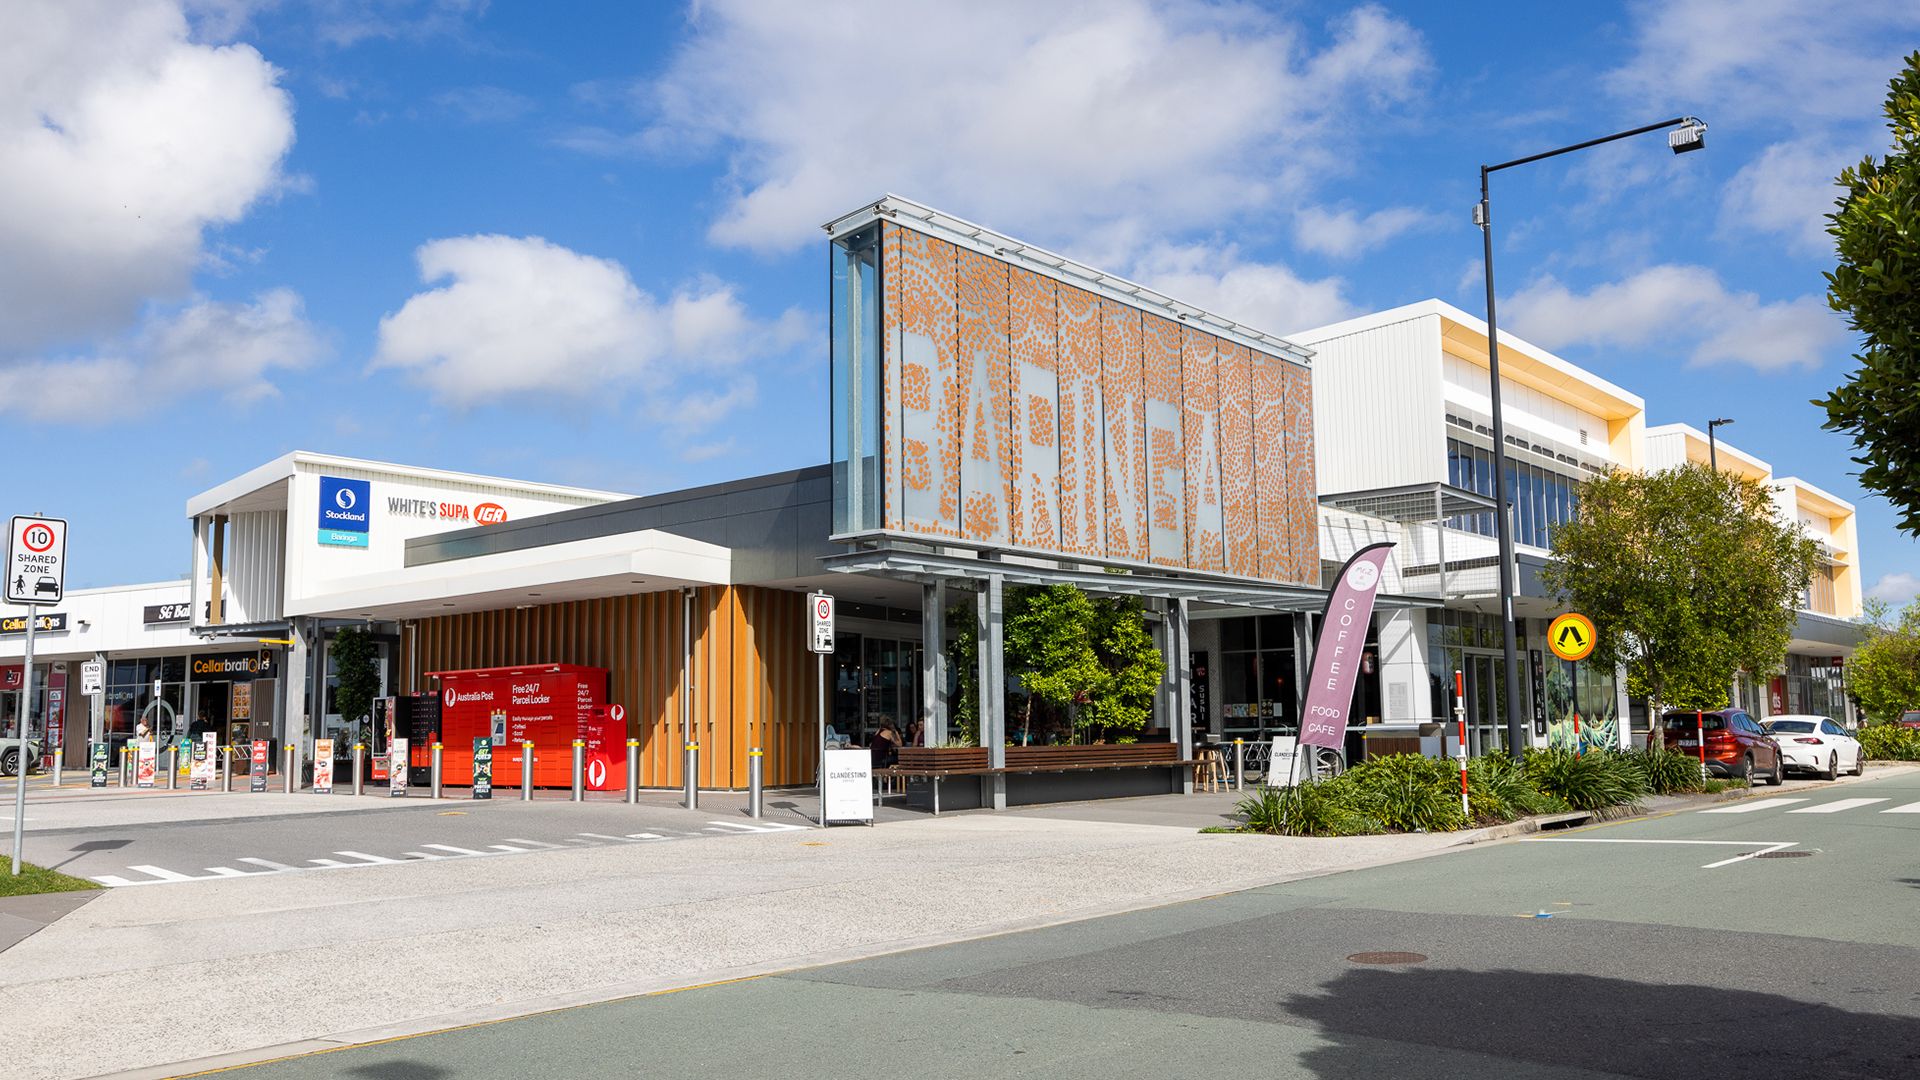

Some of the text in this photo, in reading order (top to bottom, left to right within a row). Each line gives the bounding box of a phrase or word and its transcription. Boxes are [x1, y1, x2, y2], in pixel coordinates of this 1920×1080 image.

[890, 331, 1224, 560] BARINGA
[388, 497, 469, 519] WHITE'S SUPA
[476, 506, 504, 522] IGA
[325, 510, 365, 521] Stockland
[31, 531, 48, 544] 10
[18, 554, 57, 564] SHARED
[24, 565, 50, 573] ZONE
[159, 605, 172, 619] SG
[820, 604, 828, 615] 10
[1326, 598, 1356, 690] COFFEE
[512, 683, 539, 694] Free 24/7
[457, 691, 494, 702] Australia Post
[512, 694, 550, 704] Parcel Locker
[1311, 705, 1340, 719] FOOD
[1308, 723, 1336, 736] CAFE
